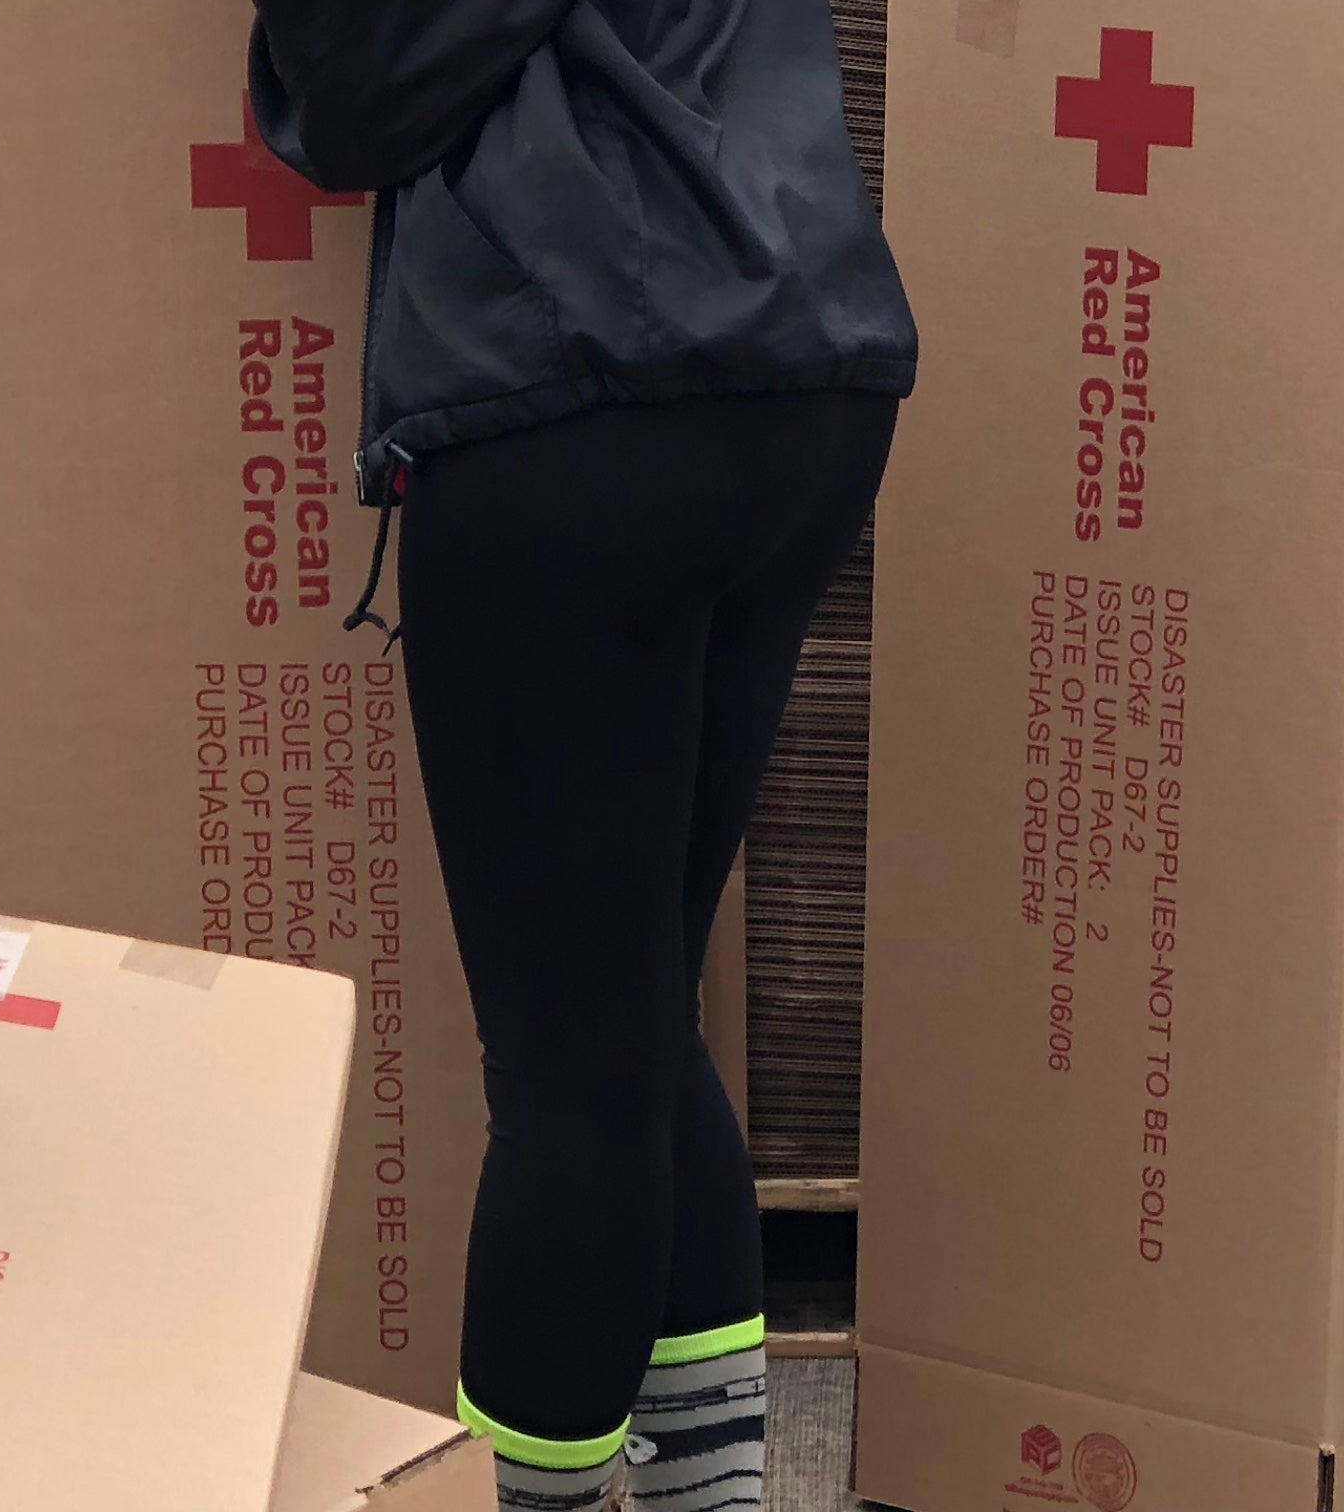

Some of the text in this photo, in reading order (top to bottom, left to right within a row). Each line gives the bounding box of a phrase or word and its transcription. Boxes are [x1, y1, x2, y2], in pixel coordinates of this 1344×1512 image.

[238, 318, 286, 628] Red Cross
[291, 315, 338, 609] American
[1074, 246, 1119, 542] Red Cross
[1117, 247, 1160, 530] American
[195, 663, 230, 866] PURCHASE
[237, 663, 269, 757] DATE
[240, 768, 271, 820] OF
[279, 663, 312, 772] ISSUE
[282, 785, 314, 869] UNIT
[322, 662, 357, 939] STOCK# D67-2
[1021, 571, 1055, 925] PURCHASE ORDER#
[1048, 575, 1088, 1072] DATE OF PRODUCTION 06/06
[1086, 580, 1121, 942] ISSUE UNIT PACK: 2
[1122, 584, 1155, 853] STOCK# D67-2
[364, 663, 410, 1353] DISASTER SUPPLIES-NOT TO BE SOLD
[1139, 589, 1188, 1263] DISASTER SUPPLIES-NOT TO BE SOLD
